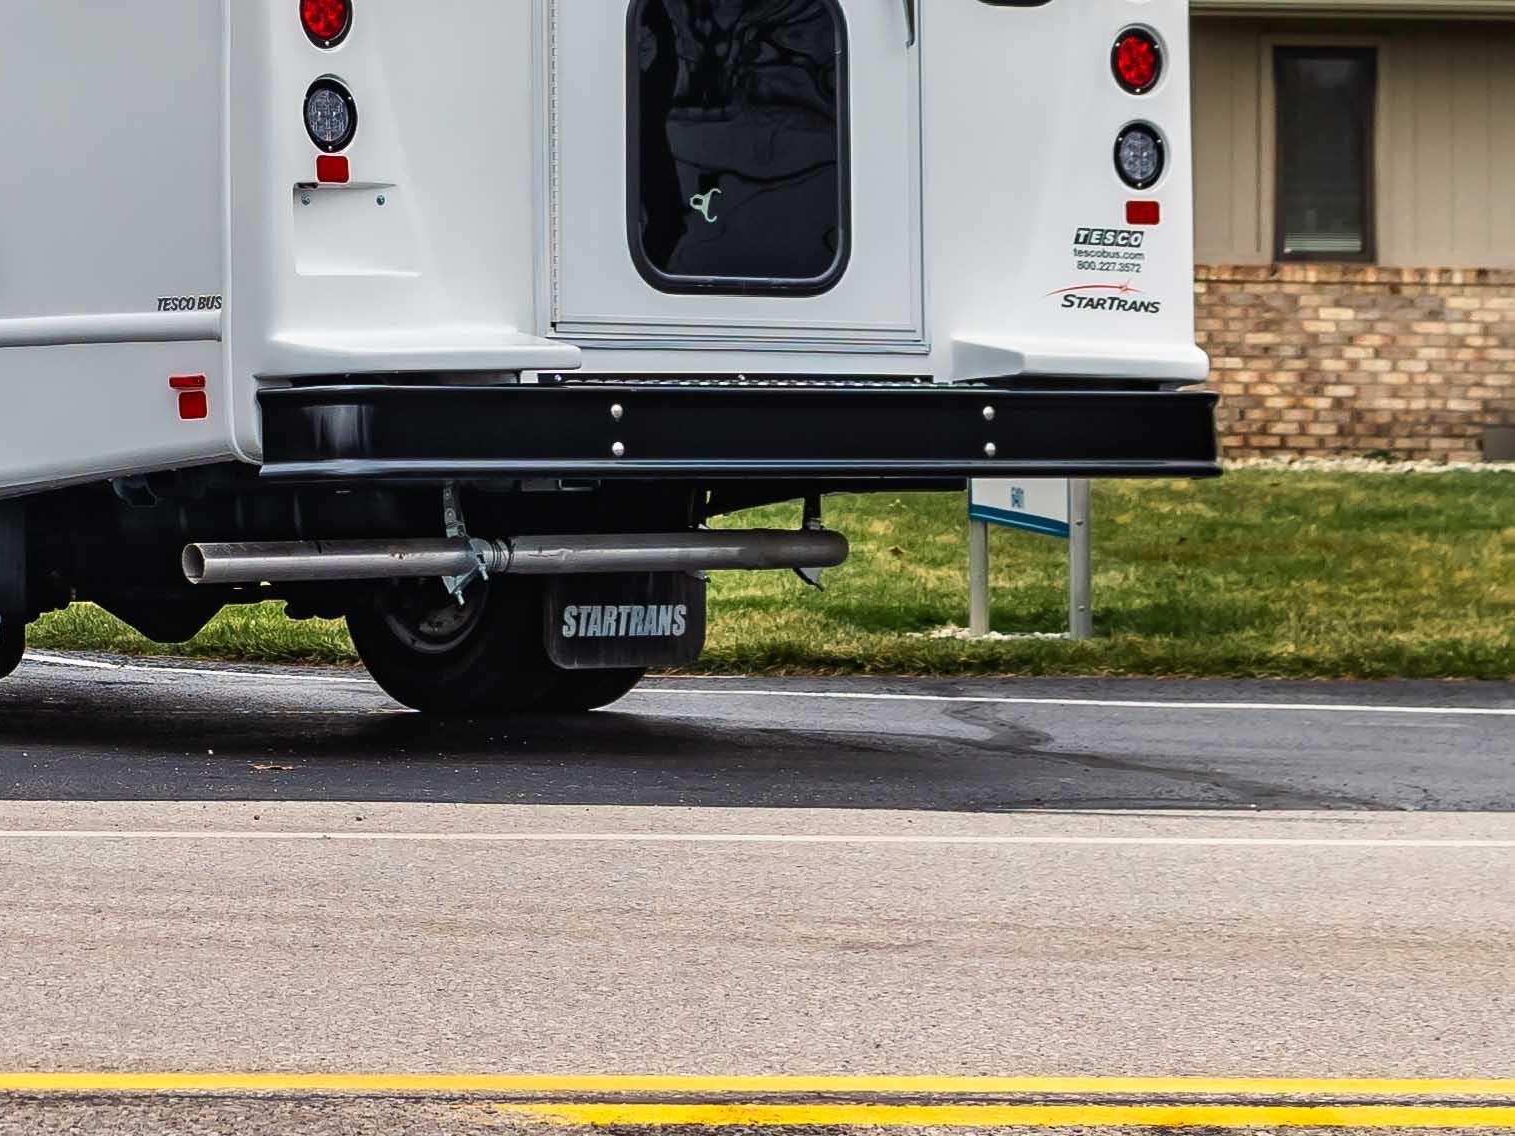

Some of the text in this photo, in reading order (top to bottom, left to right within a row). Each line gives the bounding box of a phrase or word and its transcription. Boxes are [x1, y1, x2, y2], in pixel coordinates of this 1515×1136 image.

[1074, 228, 1143, 247] TESCO
[1073, 248, 1145, 260] tescobus.com
[1077, 260, 1142, 273] 800.227.3572
[157, 295, 223, 311] TESCO BUS
[562, 604, 687, 638] STARTRANS
